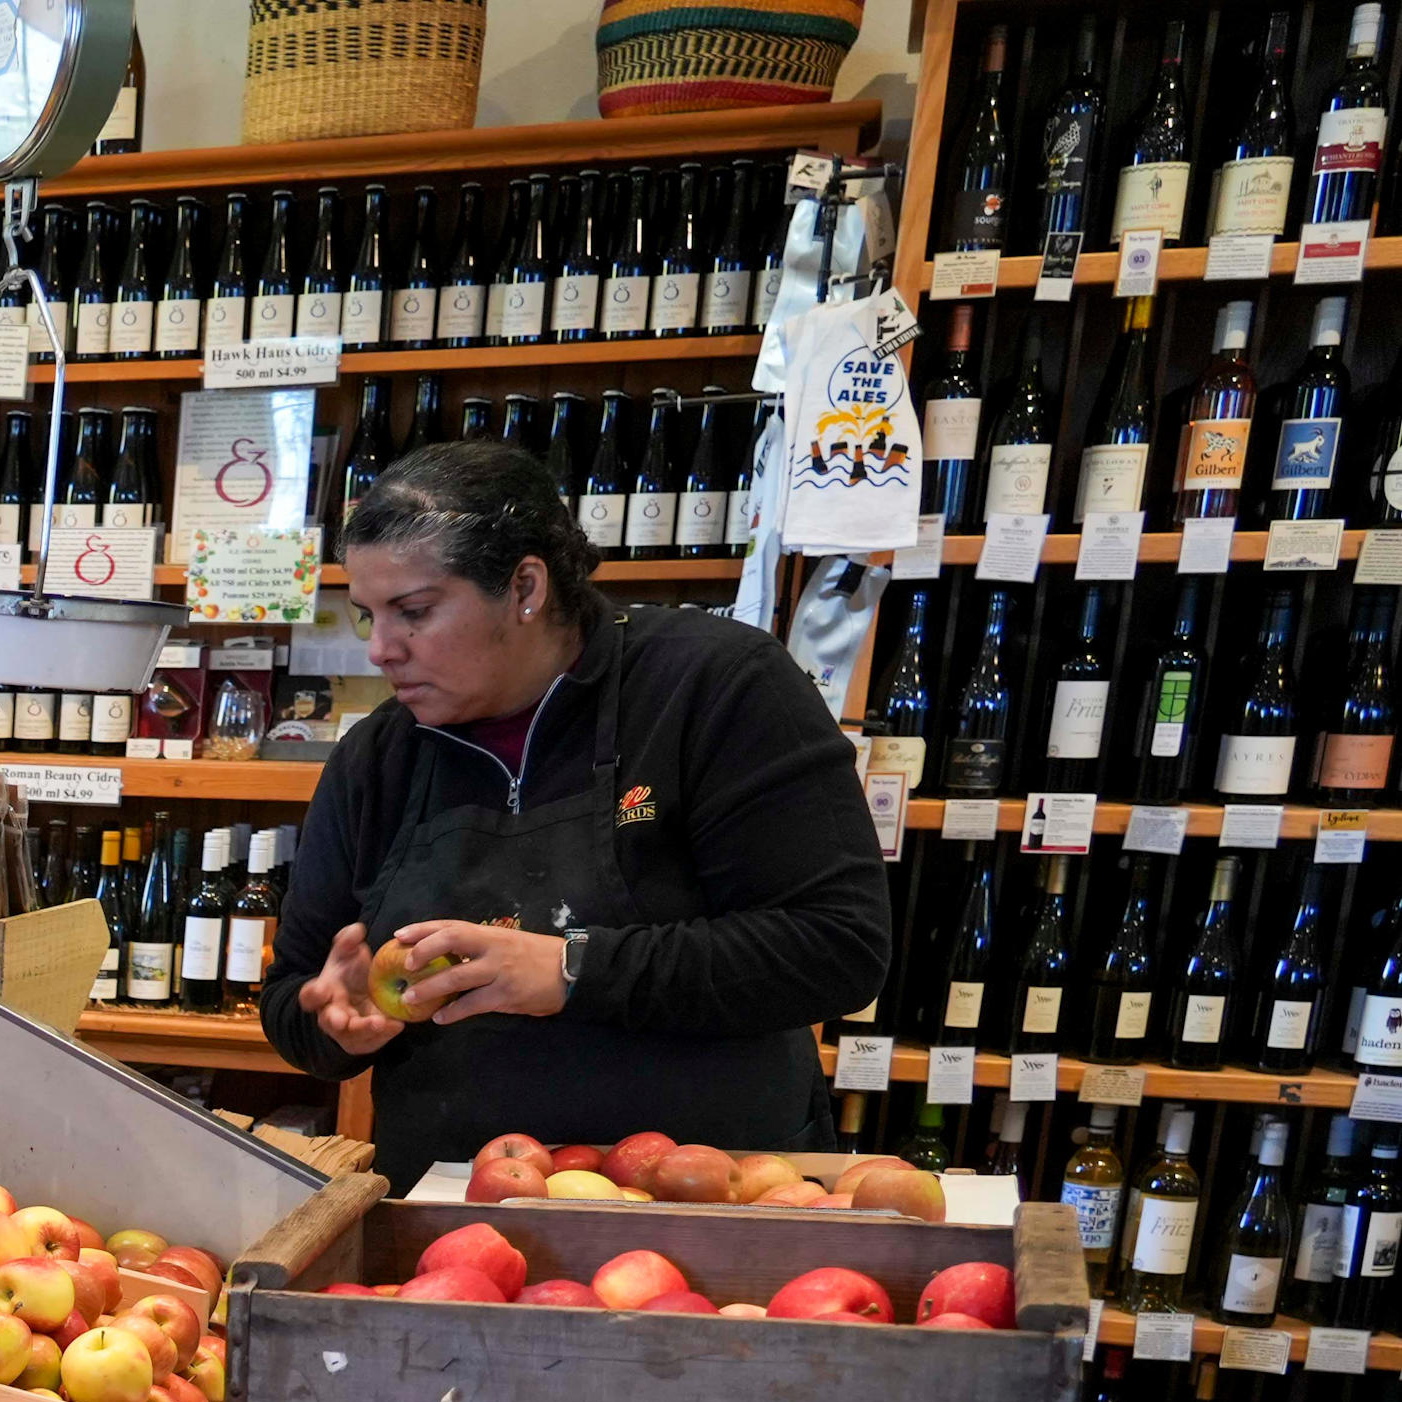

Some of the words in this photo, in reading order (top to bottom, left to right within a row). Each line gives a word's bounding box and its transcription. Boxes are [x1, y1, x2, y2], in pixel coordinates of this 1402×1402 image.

[212, 348, 250, 361] Hawk
[256, 347, 291, 359] Haus
[296, 344, 334, 356] Cidre
[236, 370, 255, 379] 500
[259, 368, 273, 378] ml
[277, 367, 306, 377] $4.99
[843, 361, 894, 375] SAVE
[852, 376, 882, 388] THE
[837, 390, 887, 403] ALES
[1195, 464, 1236, 476] Gilbert
[1282, 464, 1325, 476] Gilbert
[1065, 701, 1103, 719] Fritz
[2, 768, 40, 779] Roman
[45, 770, 82, 781] Beauty
[87, 771, 120, 782] Cidre
[46, 789, 59, 798] ml
[64, 789, 92, 799] $4.99
